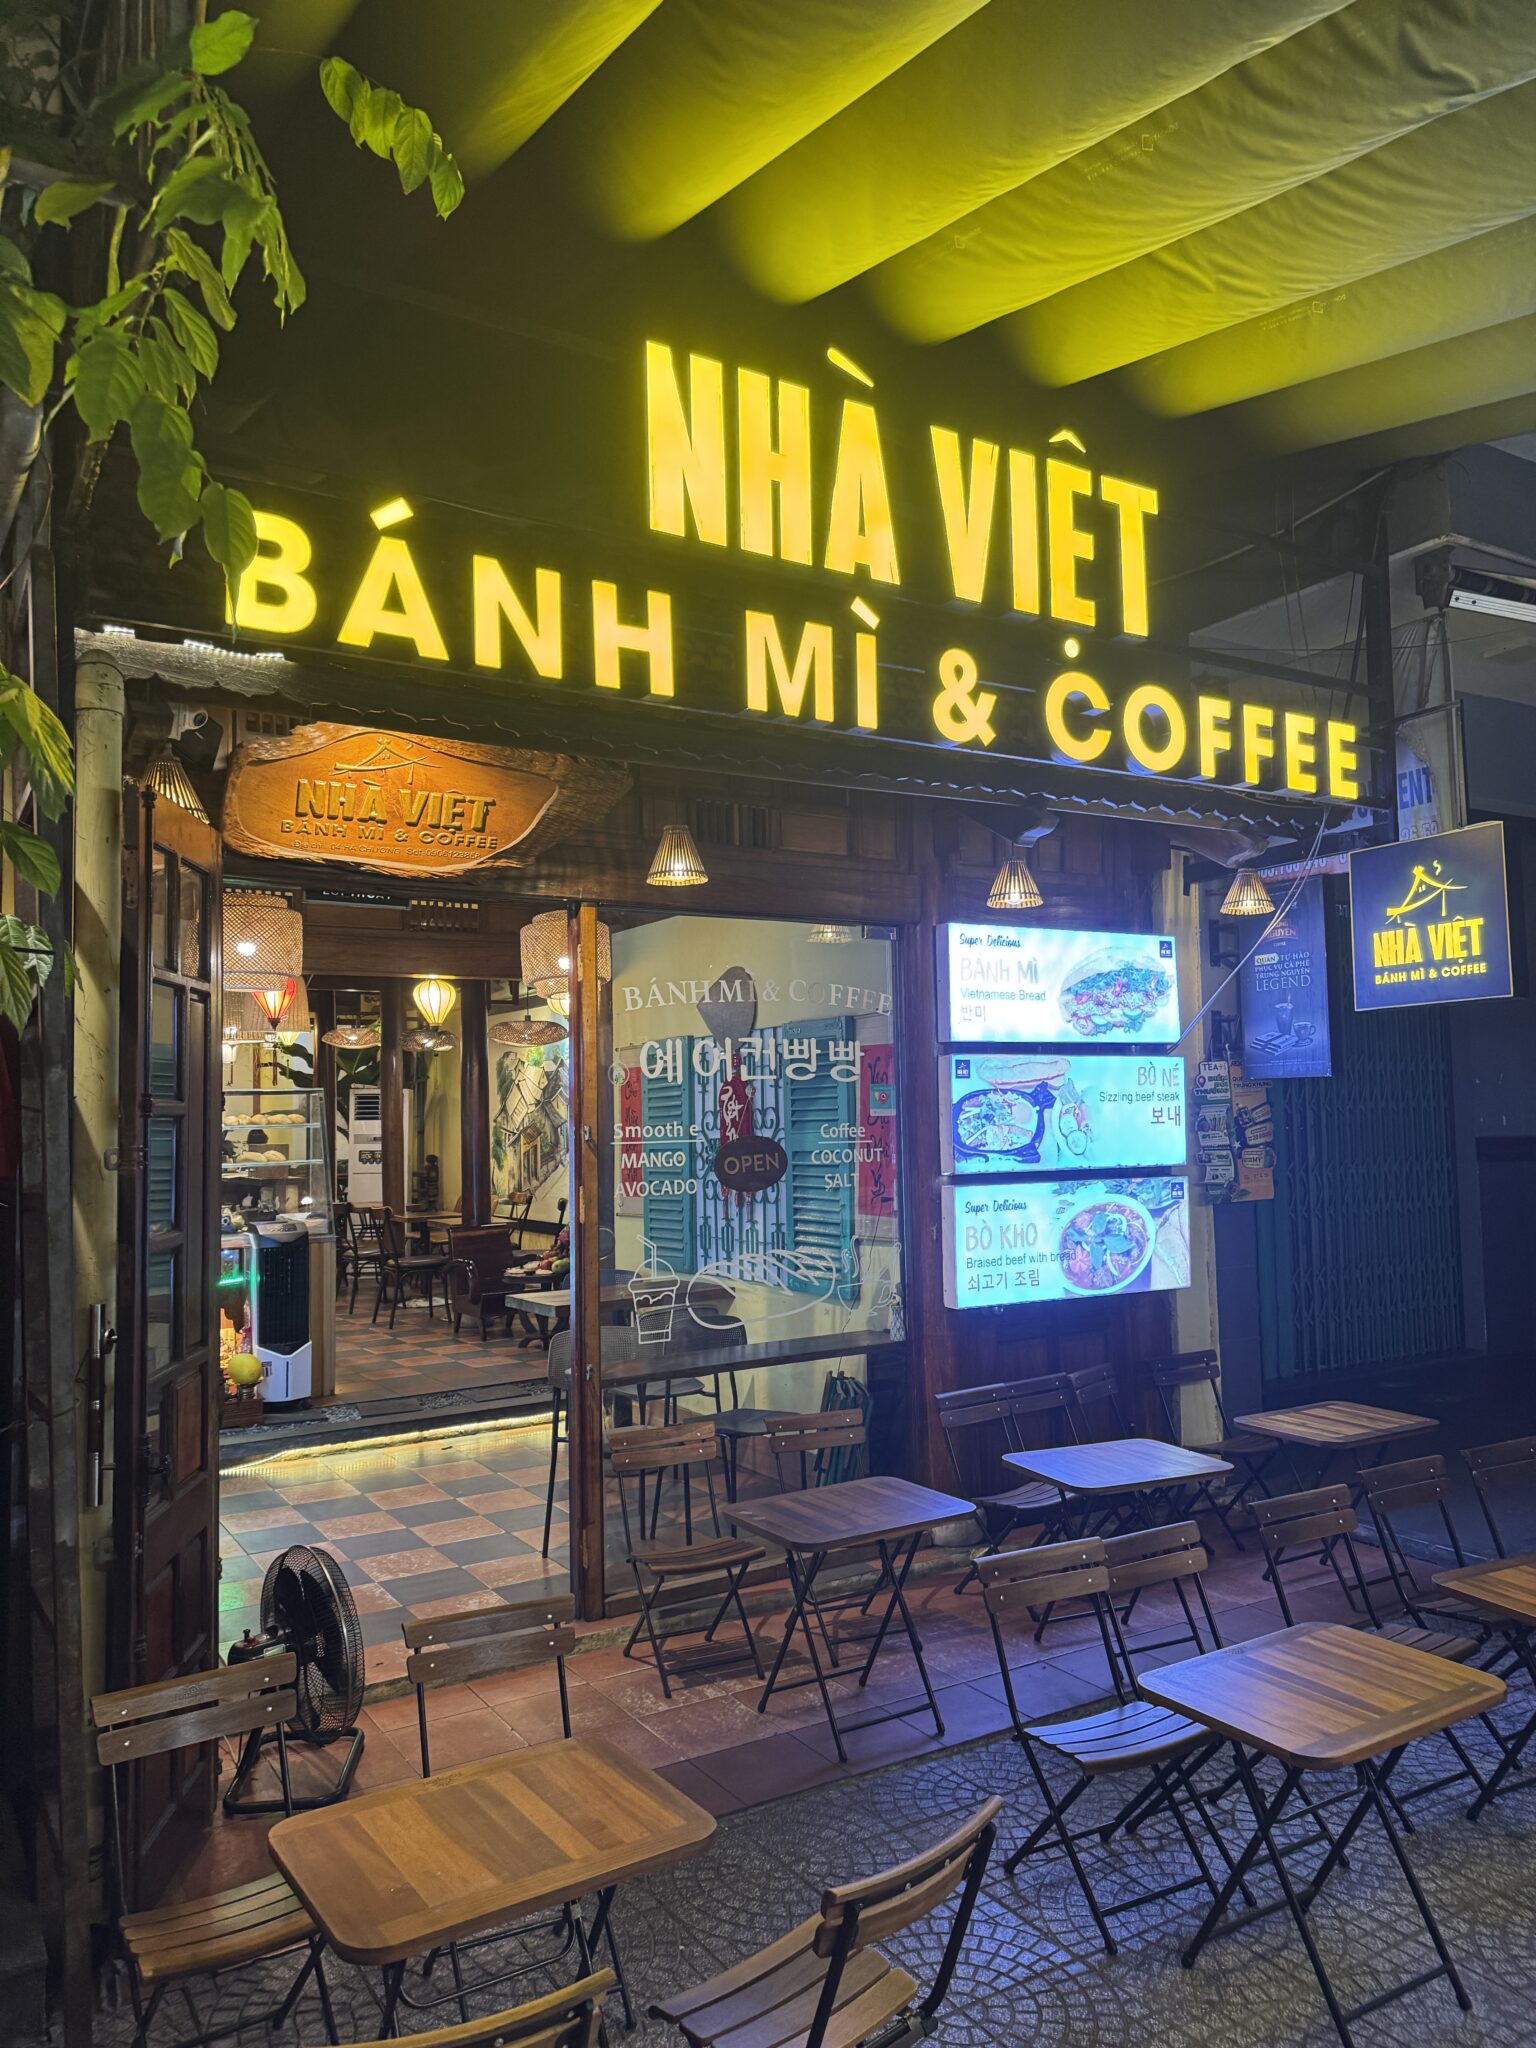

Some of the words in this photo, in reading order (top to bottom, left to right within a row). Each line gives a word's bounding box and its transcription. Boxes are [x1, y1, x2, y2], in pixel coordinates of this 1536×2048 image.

[645, 340, 901, 586] NHÀ
[226, 497, 675, 698] BÁNH
[744, 597, 881, 730] MÌ
[932, 647, 997, 747] &
[1045, 670, 1359, 800] COFFEE
[294, 778, 389, 825] NHÀ
[398, 788, 497, 835] VIỆT
[280, 818, 348, 838] BÁNH
[357, 823, 385, 841] MÌ
[393, 828, 409, 842] &
[418, 830, 499, 850] COFFEE
[960, 933, 983, 949] Super
[987, 934, 1021, 948] Delicious
[1373, 922, 1423, 968] NHÀ
[1427, 916, 1484, 963] VIỆT
[1017, 956, 1039, 985] MÌ
[1256, 970, 1280, 979] TRUNG
[1281, 967, 1311, 977] NGUYÊN
[1374, 971, 1407, 985] BÁNH
[1411, 968, 1425, 981] MÌ
[1429, 968, 1438, 979] &
[1441, 962, 1488, 978] COFFEE
[1256, 974, 1312, 992] LEGEND
[621, 977, 713, 1012] BÁNH
[762, 979, 781, 1002] &
[788, 979, 893, 1017] COFFEE
[961, 987, 1016, 1000] Vietnamese
[1019, 989, 1047, 1001] Bread
[961, 1004, 986, 1022] 반미
[1137, 1061, 1157, 1087] BÒ
[1162, 1062, 1181, 1088] NÉ
[1099, 1091, 1133, 1105] Sizzling
[1135, 1091, 1155, 1102] beef
[1157, 1091, 1180, 1102] steak
[820, 1123, 866, 1138] Coffee
[621, 1151, 686, 1169] MANGO
[723, 1152, 780, 1175] OPEN
[811, 1148, 883, 1165] COCONUT
[614, 1179, 697, 1198] AVOCADO
[824, 1173, 859, 1189] SALT
[965, 1201, 989, 1216] Super
[993, 1199, 1028, 1212] Delicious
[965, 1218, 993, 1252] BÒ
[1000, 1222, 1038, 1250] KHO
[966, 1255, 1003, 1269] Braised
[1005, 1252, 1027, 1266] beef
[1029, 1251, 1048, 1263] with
[1050, 1251, 1077, 1263] bread
[967, 1271, 1008, 1292] 쇠고기
[1014, 1268, 1040, 1287] 조림
